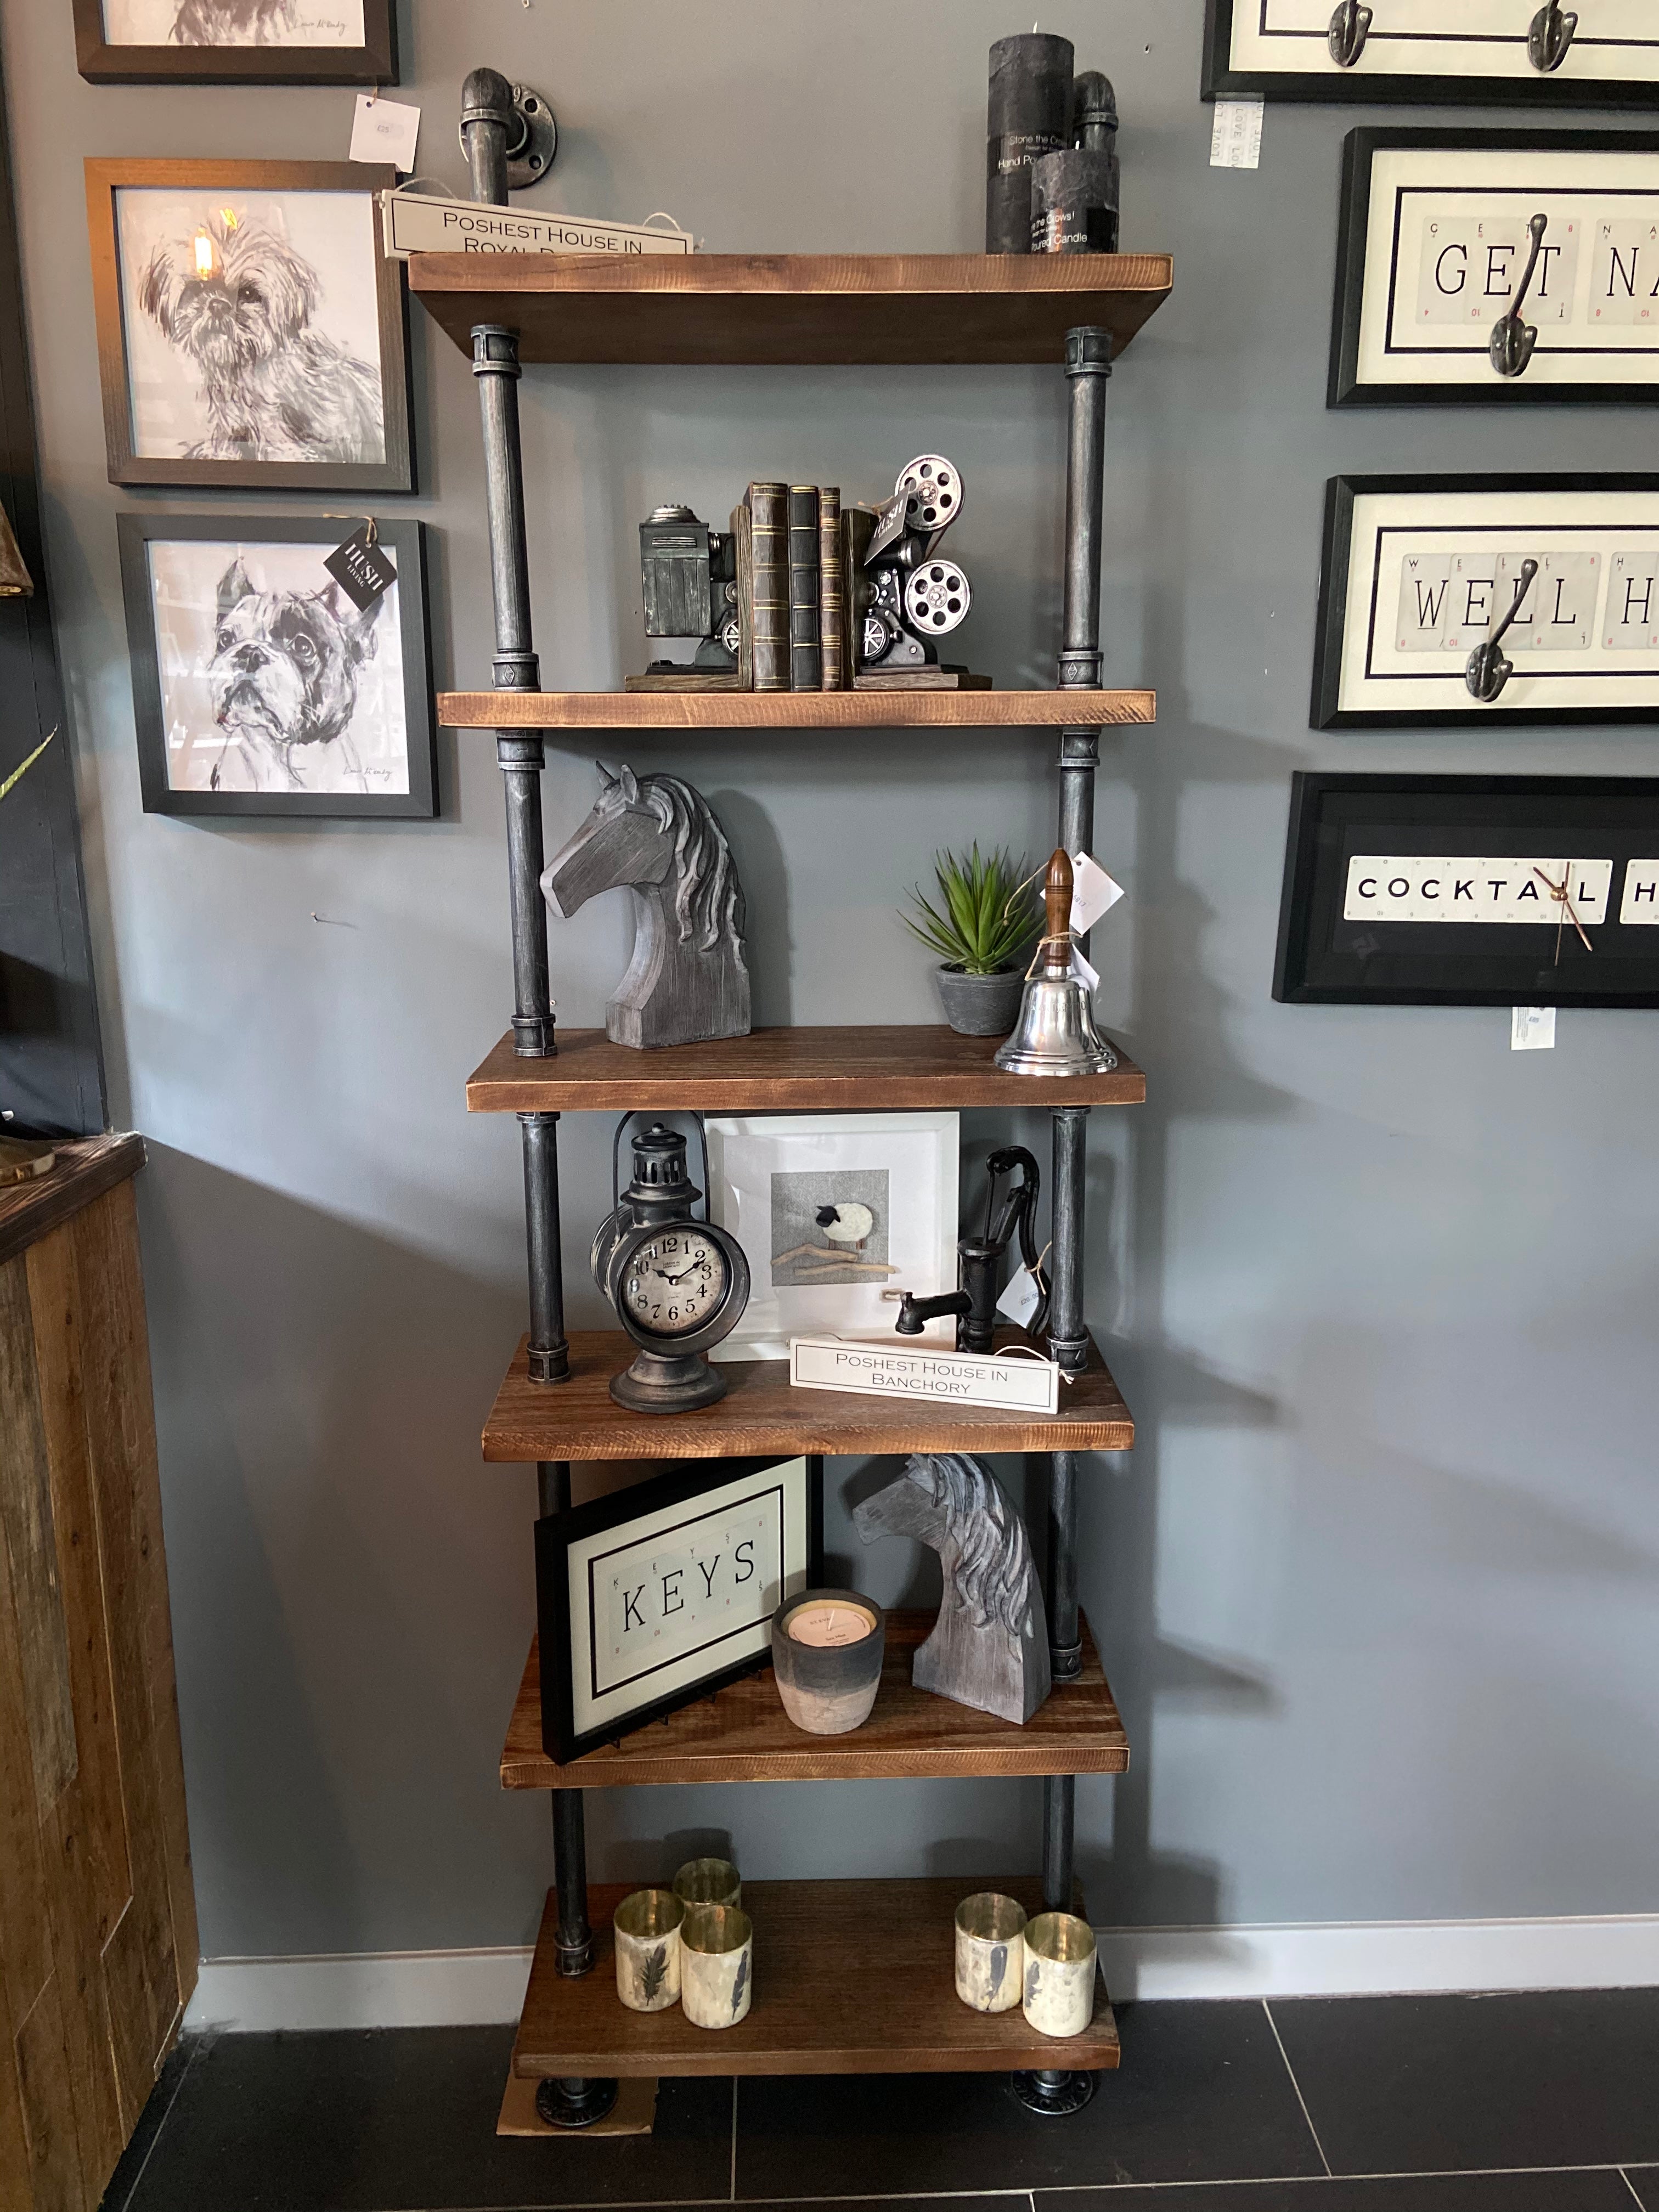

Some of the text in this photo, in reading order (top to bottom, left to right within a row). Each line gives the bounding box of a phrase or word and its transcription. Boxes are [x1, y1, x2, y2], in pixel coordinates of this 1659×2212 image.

[998, 156, 1020, 170] Hand
[444, 212, 641, 255] POSHEST HOUSE IN
[1054, 232, 1087, 245] Candle
[1436, 244, 1561, 296] GET
[345, 543, 383, 591] HUSH
[347, 564, 365, 588] LIVING
[1414, 578, 1576, 627] WELL
[661, 1238, 678, 1254] 12
[684, 1239, 690, 1255] 1
[695, 1250, 707, 1264] 2
[635, 1260, 649, 1276] 10
[702, 1265, 712, 1280] 3
[696, 1284, 708, 1298] 4
[637, 1294, 648, 1309] 8
[685, 1298, 696, 1313] 5
[651, 1304, 661, 1319] 7
[668, 1306, 679, 1321] 6
[836, 1353, 1008, 1382] POSHEST HOUSE IN
[872, 1373, 970, 1394] BANCHORY
[623, 1540, 754, 1633] KEYS
